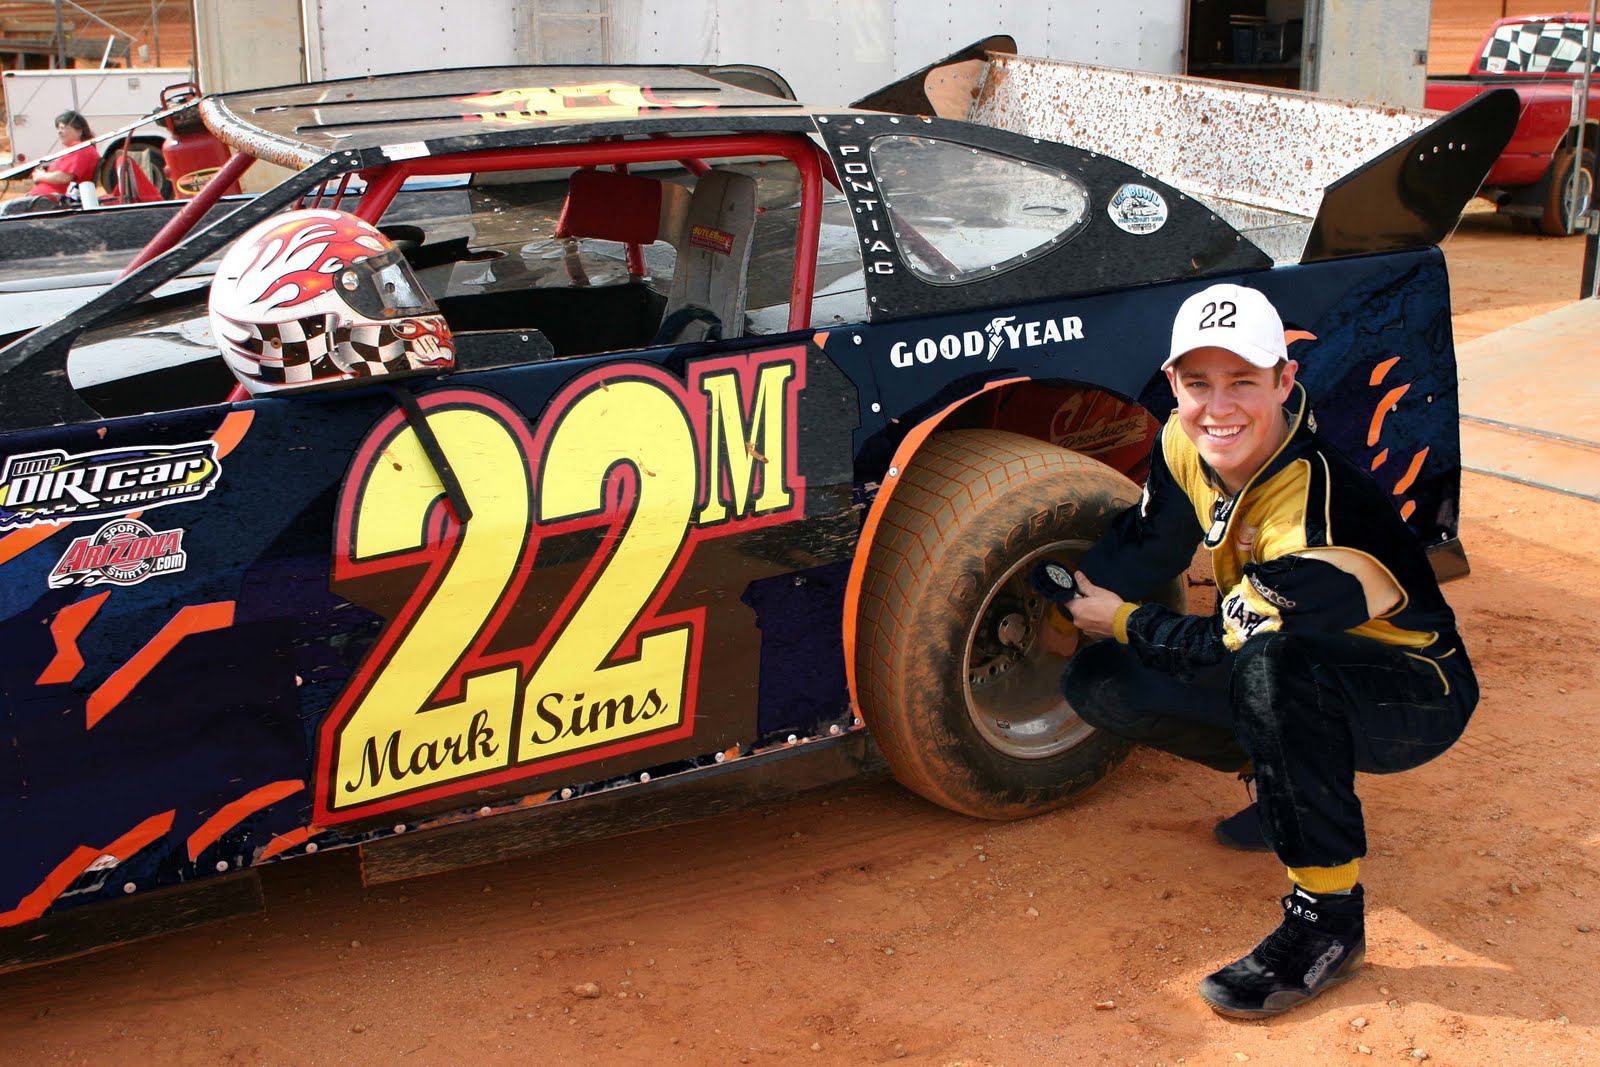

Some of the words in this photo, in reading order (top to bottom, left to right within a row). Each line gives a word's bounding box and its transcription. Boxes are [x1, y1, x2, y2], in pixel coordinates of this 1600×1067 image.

[839, 146, 894, 274] PONTIAC
[1199, 301, 1237, 331] 22
[103, 524, 144, 541] SPORT
[56, 532, 181, 575] ARIZONA
[107, 562, 150, 580] SHIRTS
[345, 709, 499, 792] Mark
[531, 687, 668, 745] Sims
